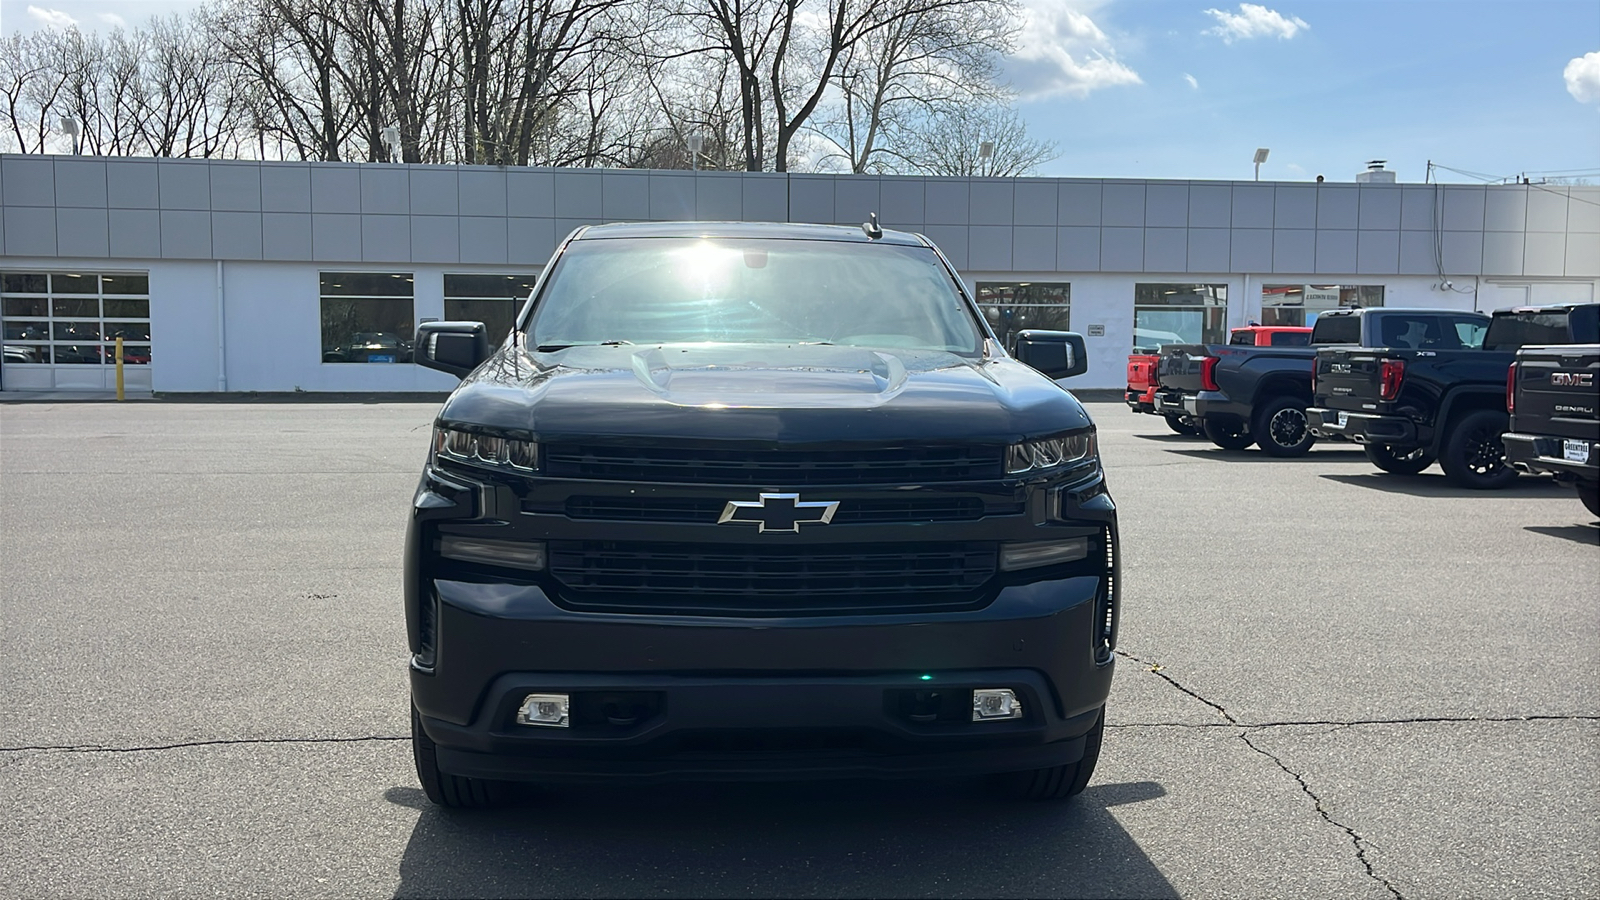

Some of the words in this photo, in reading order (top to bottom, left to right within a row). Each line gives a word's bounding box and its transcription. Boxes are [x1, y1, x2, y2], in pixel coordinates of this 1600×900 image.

[1551, 373, 1593, 386] GMC
[1555, 405, 1593, 413] DENALI
[1565, 443, 1588, 452] GREENTREE
